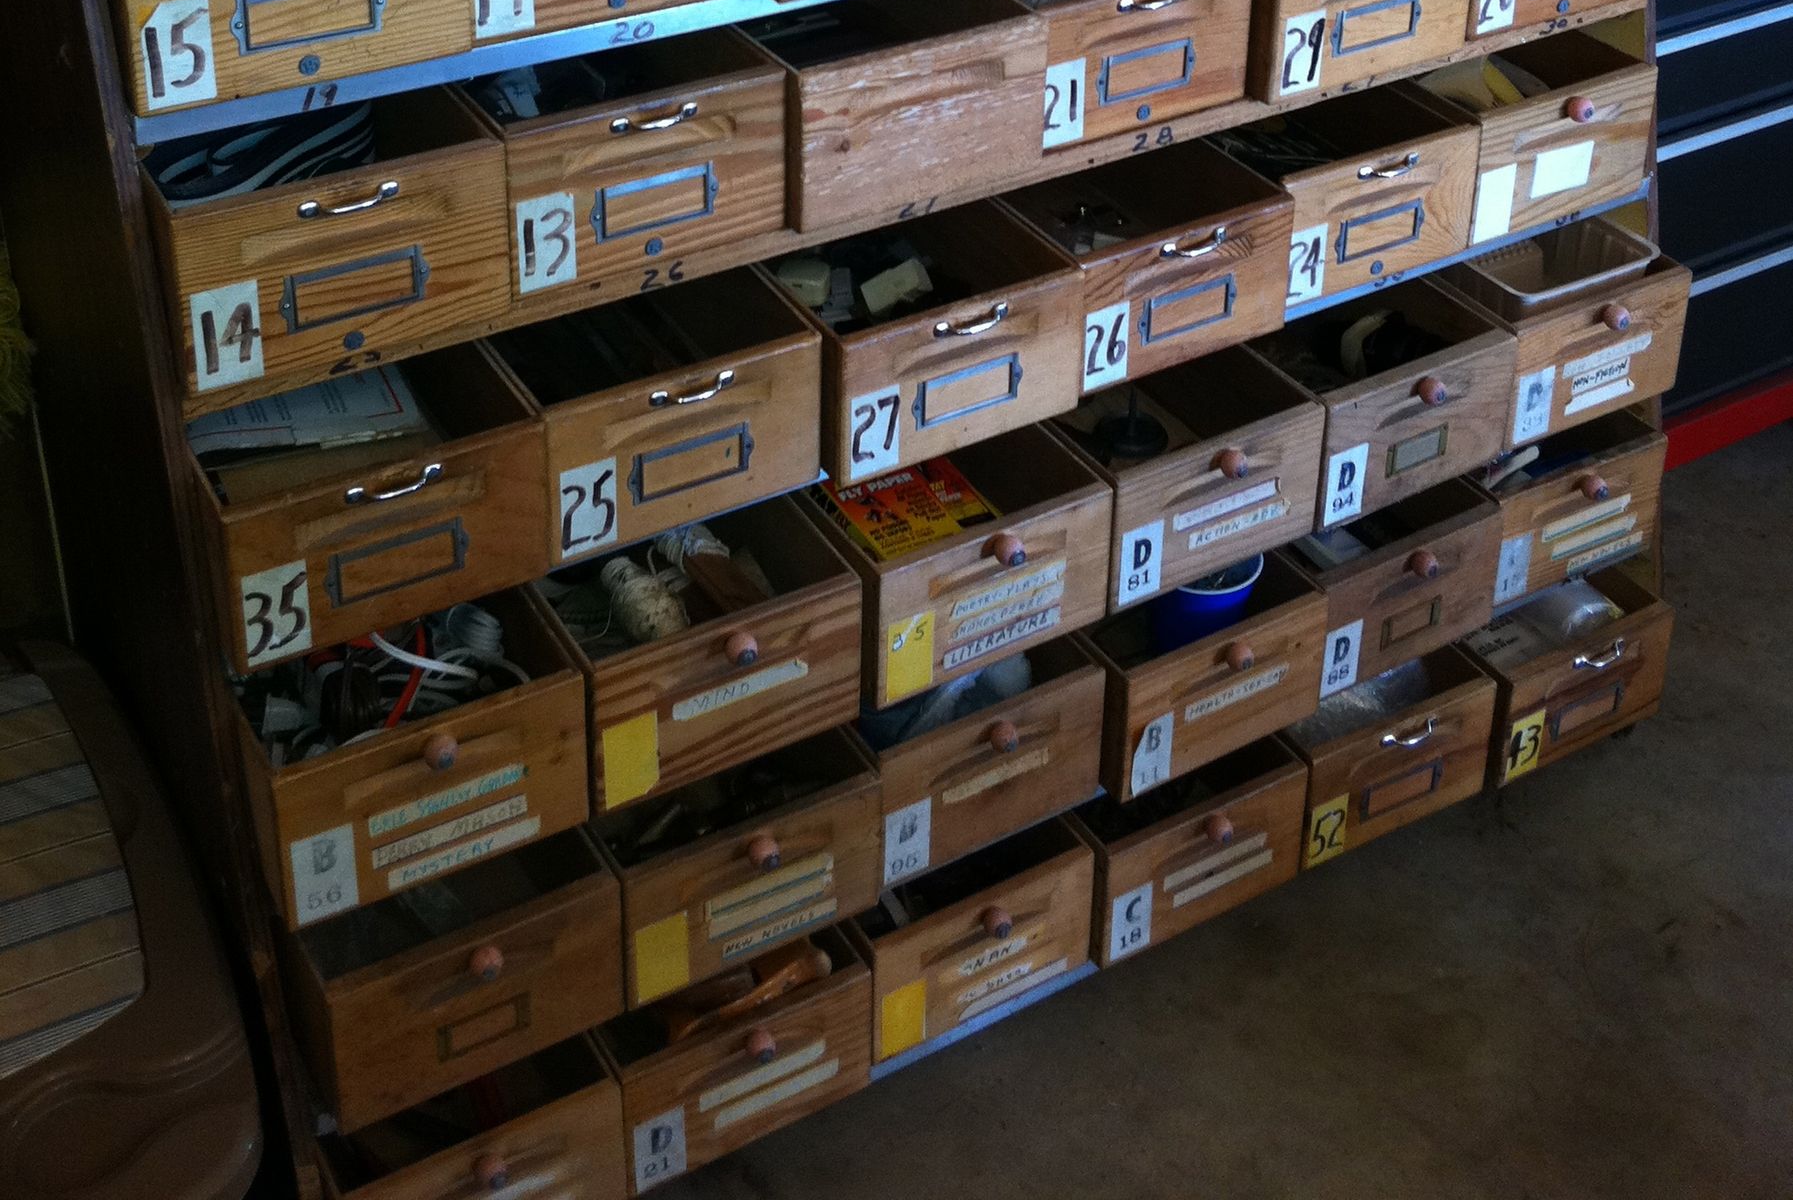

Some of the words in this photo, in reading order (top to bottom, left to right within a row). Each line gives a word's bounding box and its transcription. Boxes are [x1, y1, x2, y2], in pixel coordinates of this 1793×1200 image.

[144, 7, 210, 99] 15
[610, 19, 655, 44] 20
[1281, 17, 1326, 89] 29
[1043, 78, 1078, 131] 21
[1130, 125, 1174, 153] 28
[522, 207, 574, 278] 13
[640, 259, 686, 291] 26
[200, 302, 262, 375] 14
[1085, 312, 1125, 378] 26
[851, 394, 900, 464] 27
[838, 485, 863, 502] FLY
[866, 472, 914, 493] PAPER
[1338, 461, 1356, 492] D
[562, 468, 616, 551] 25
[1133, 538, 1152, 571] D
[1127, 569, 1150, 592] 81
[243, 571, 308, 658] 35
[949, 610, 1050, 666] LITERATURE
[1333, 635, 1351, 664] D
[1311, 808, 1346, 857] 52
[313, 838, 337, 875] B
[402, 836, 495, 882] MYSTERY
[1125, 896, 1143, 923] C
